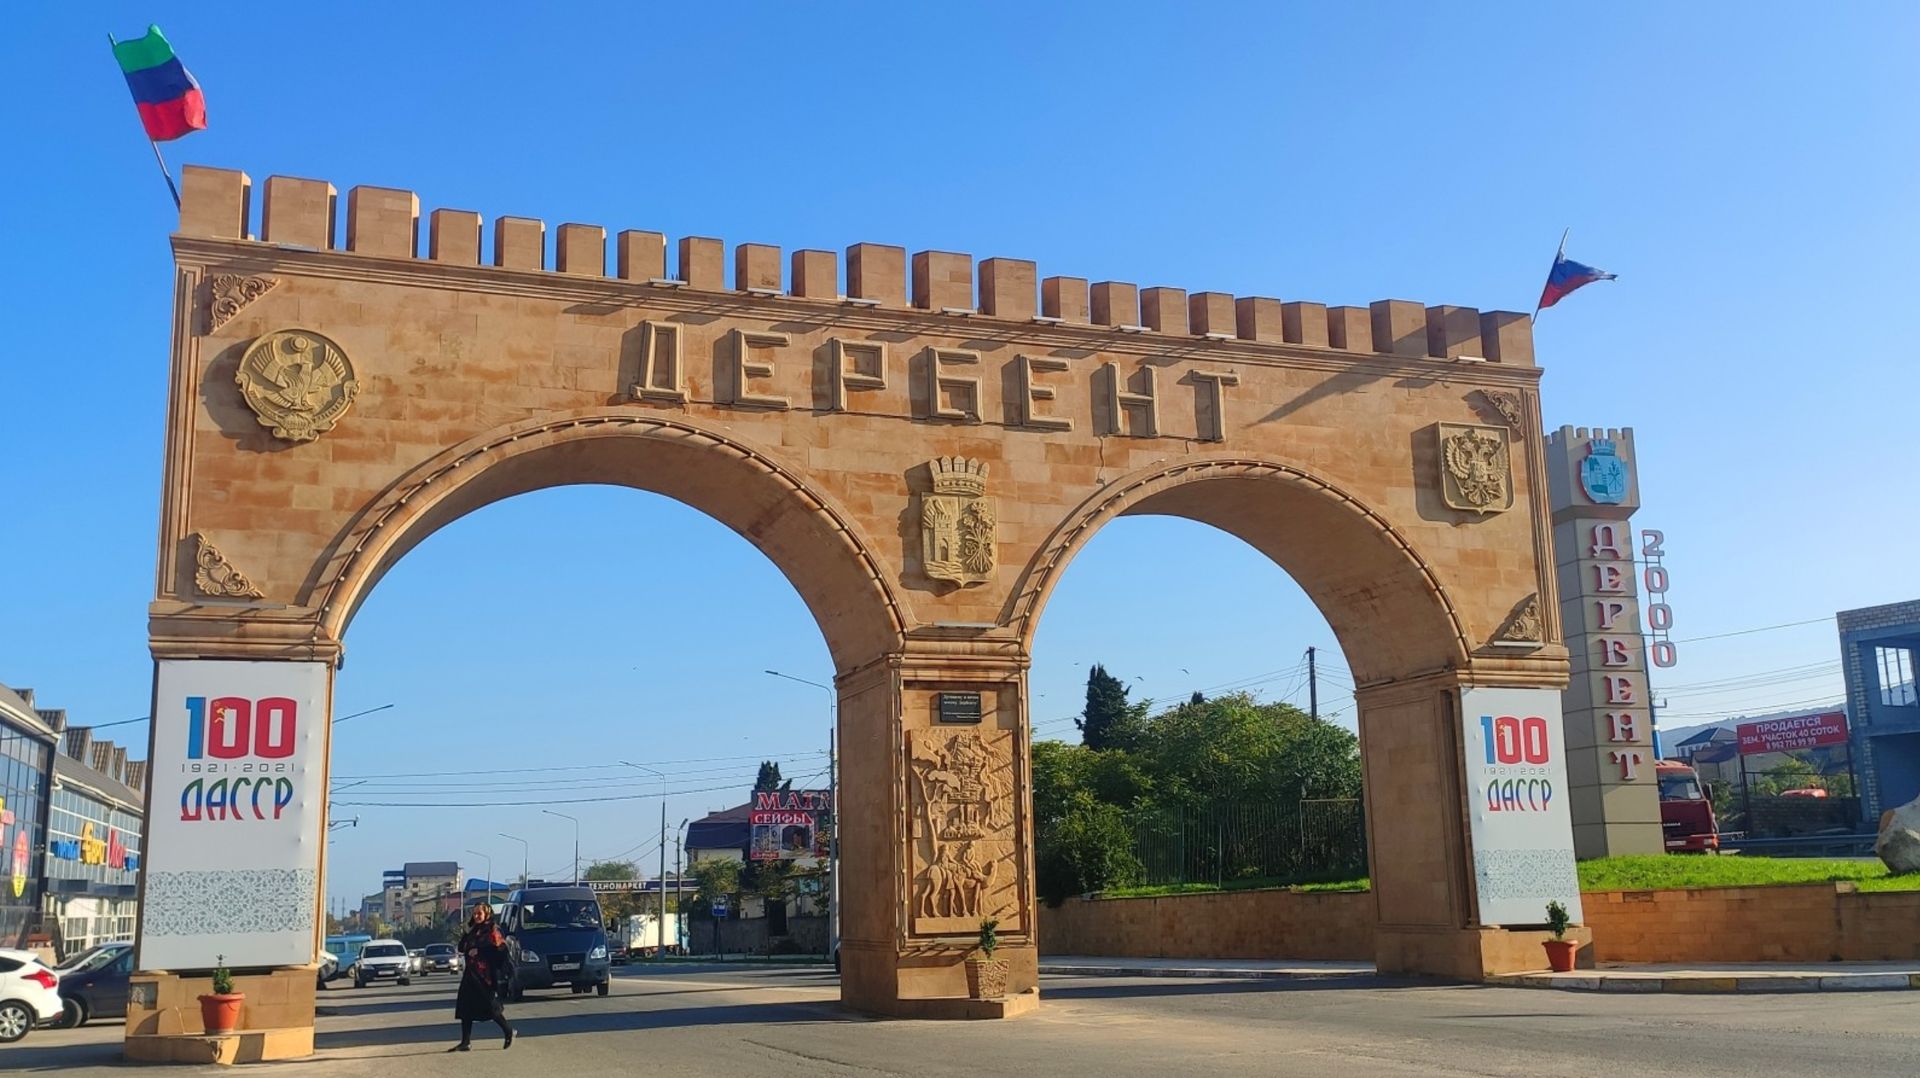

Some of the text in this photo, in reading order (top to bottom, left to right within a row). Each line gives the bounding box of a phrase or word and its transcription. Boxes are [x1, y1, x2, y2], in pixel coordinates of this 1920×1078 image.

[632, 320, 1241, 442] ДЕРБЕНТ
[1642, 530, 1677, 668] 2000
[1593, 524, 1645, 780] ДЕРБЕНТ
[186, 696, 297, 759] 100
[1480, 716, 1549, 764] 100
[1757, 717, 1821, 733] ПРОДАЕТСЯ
[1761, 730, 1798, 743] УЧАСТОК
[1799, 730, 1809, 738] 40
[1810, 725, 1840, 736] СОТОК
[180, 777, 293, 821] ДАССР
[1487, 778, 1552, 811] ДАССР
[754, 812, 807, 824] СЕЙФЫ
[589, 881, 647, 890] ТЕХНОМАРКЕТ
